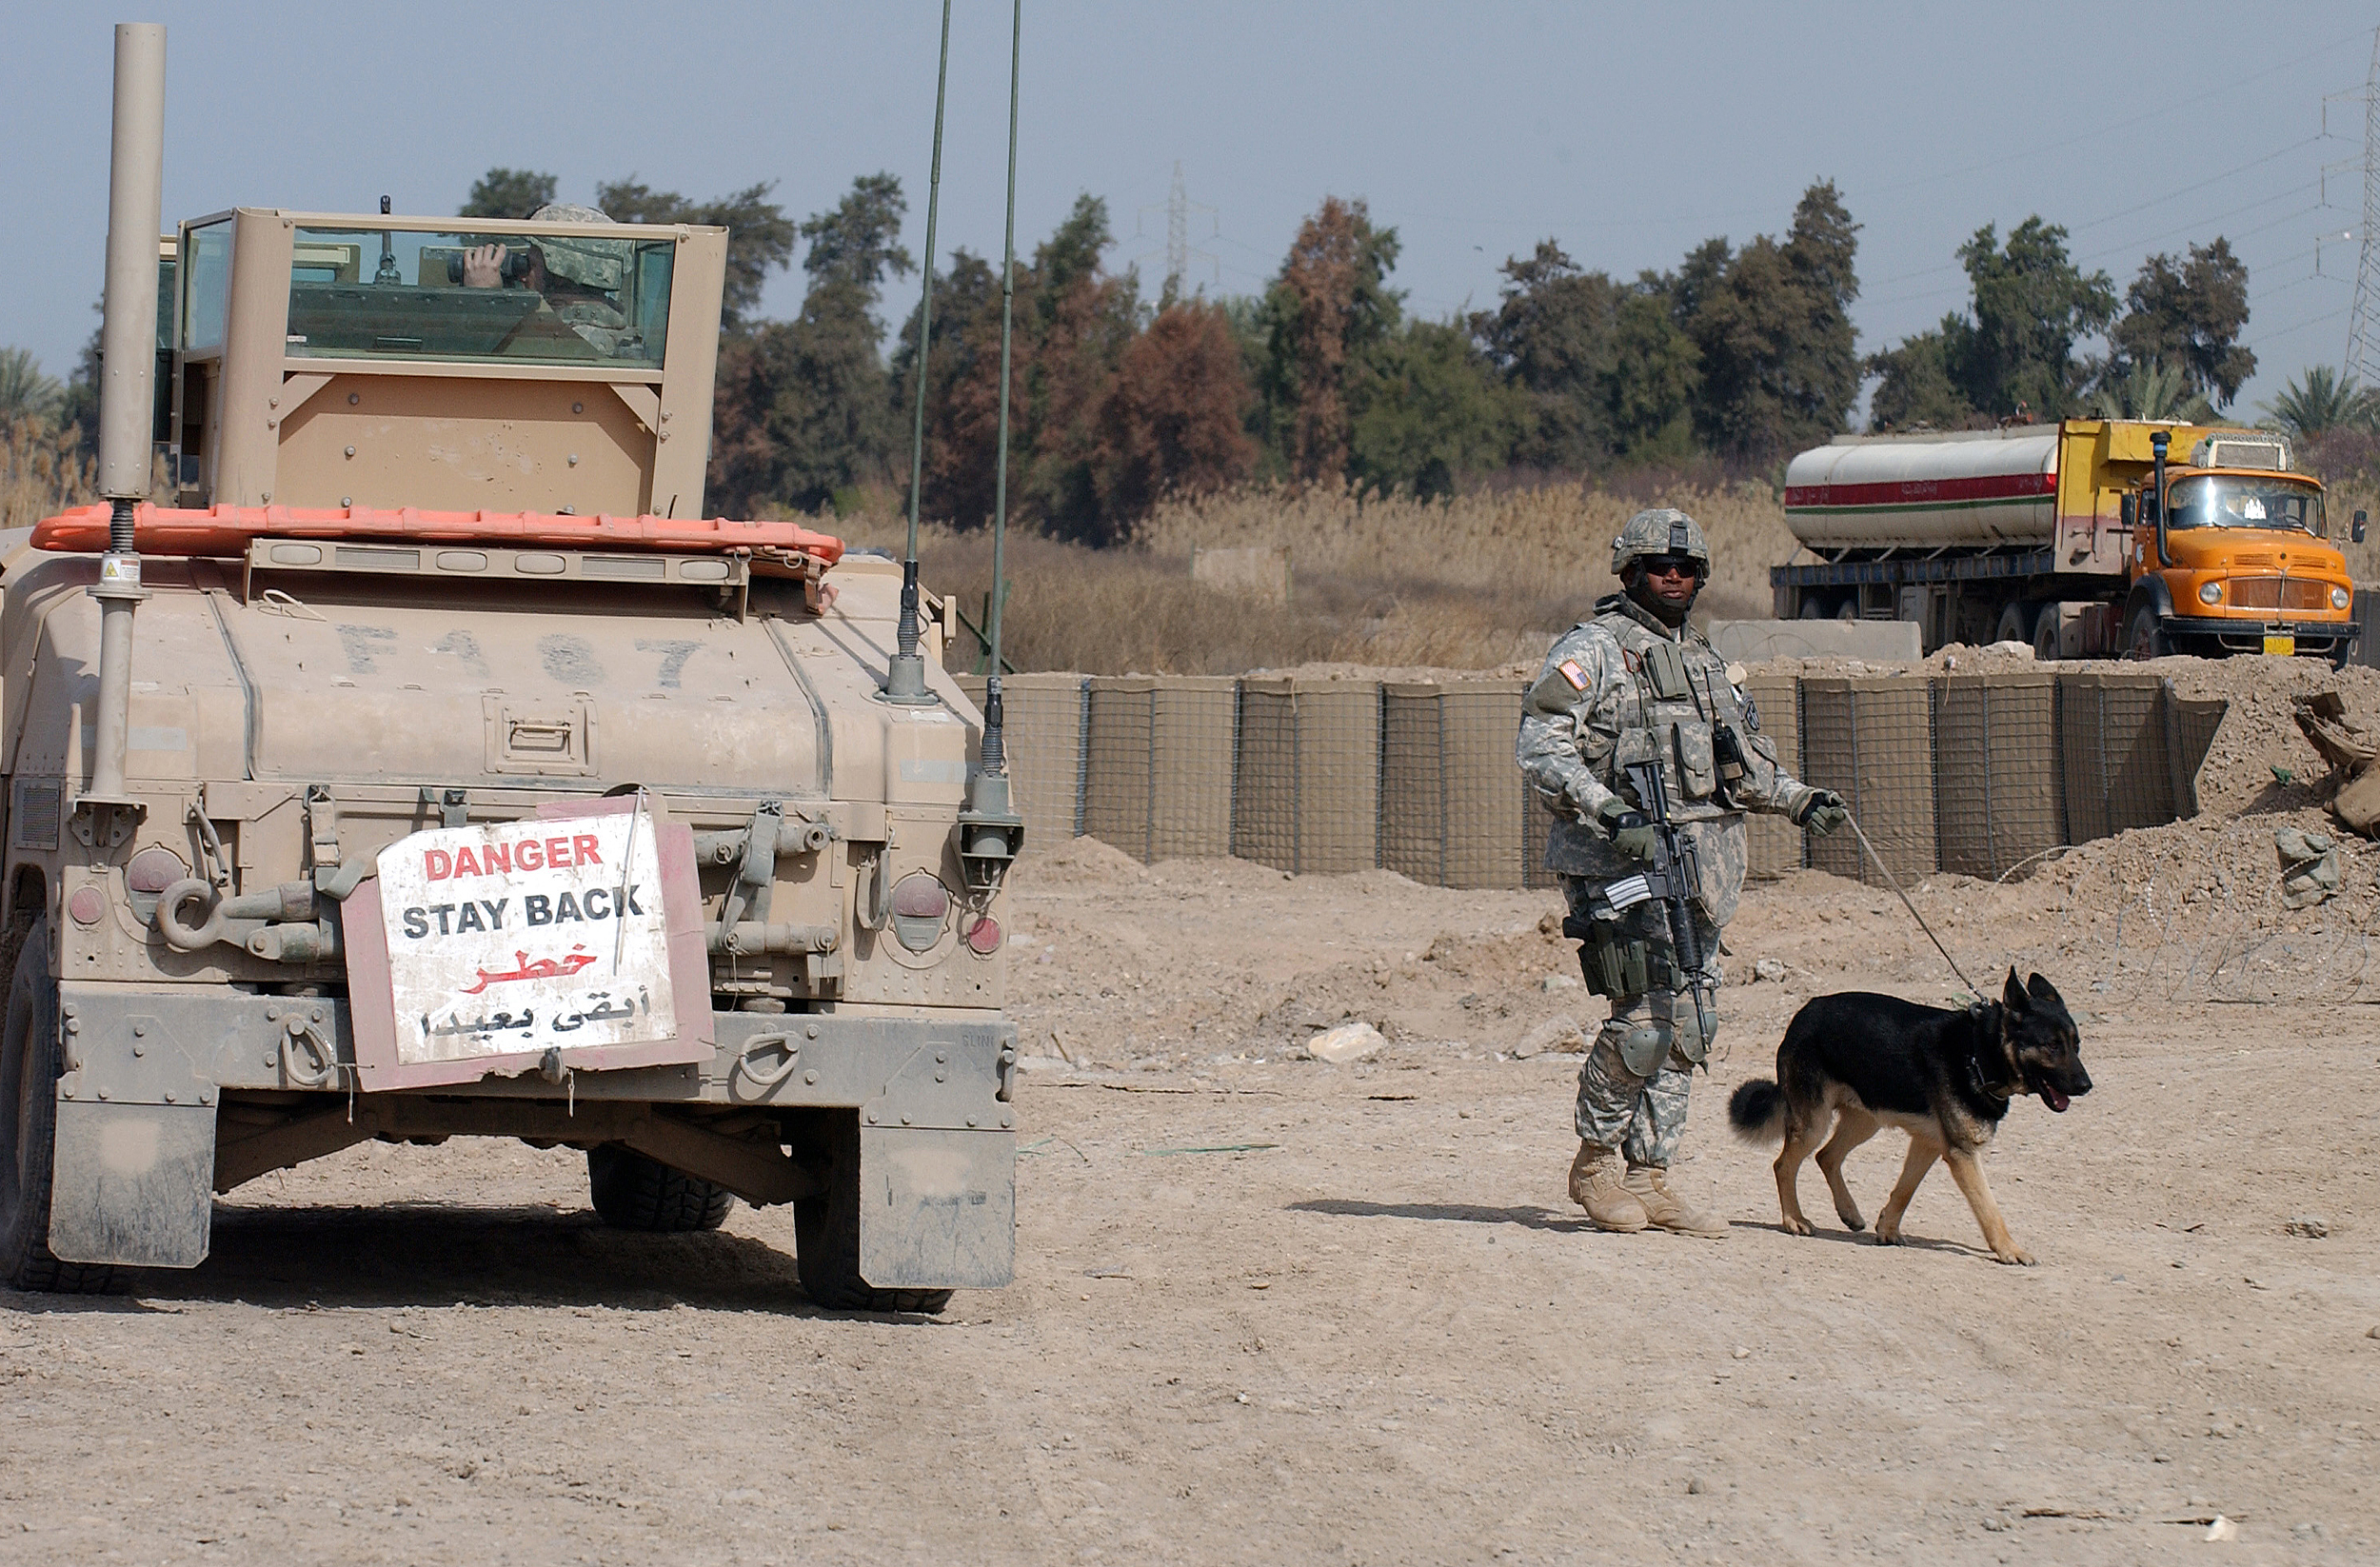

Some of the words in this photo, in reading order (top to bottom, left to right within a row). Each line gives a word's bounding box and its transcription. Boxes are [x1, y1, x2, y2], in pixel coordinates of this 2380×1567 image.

[425, 834, 603, 882] DANGER
[403, 898, 509, 940] STAY
[525, 884, 645, 927] BACK
[458, 943, 598, 995] خطر
[420, 1007, 534, 1041] بعيدا
